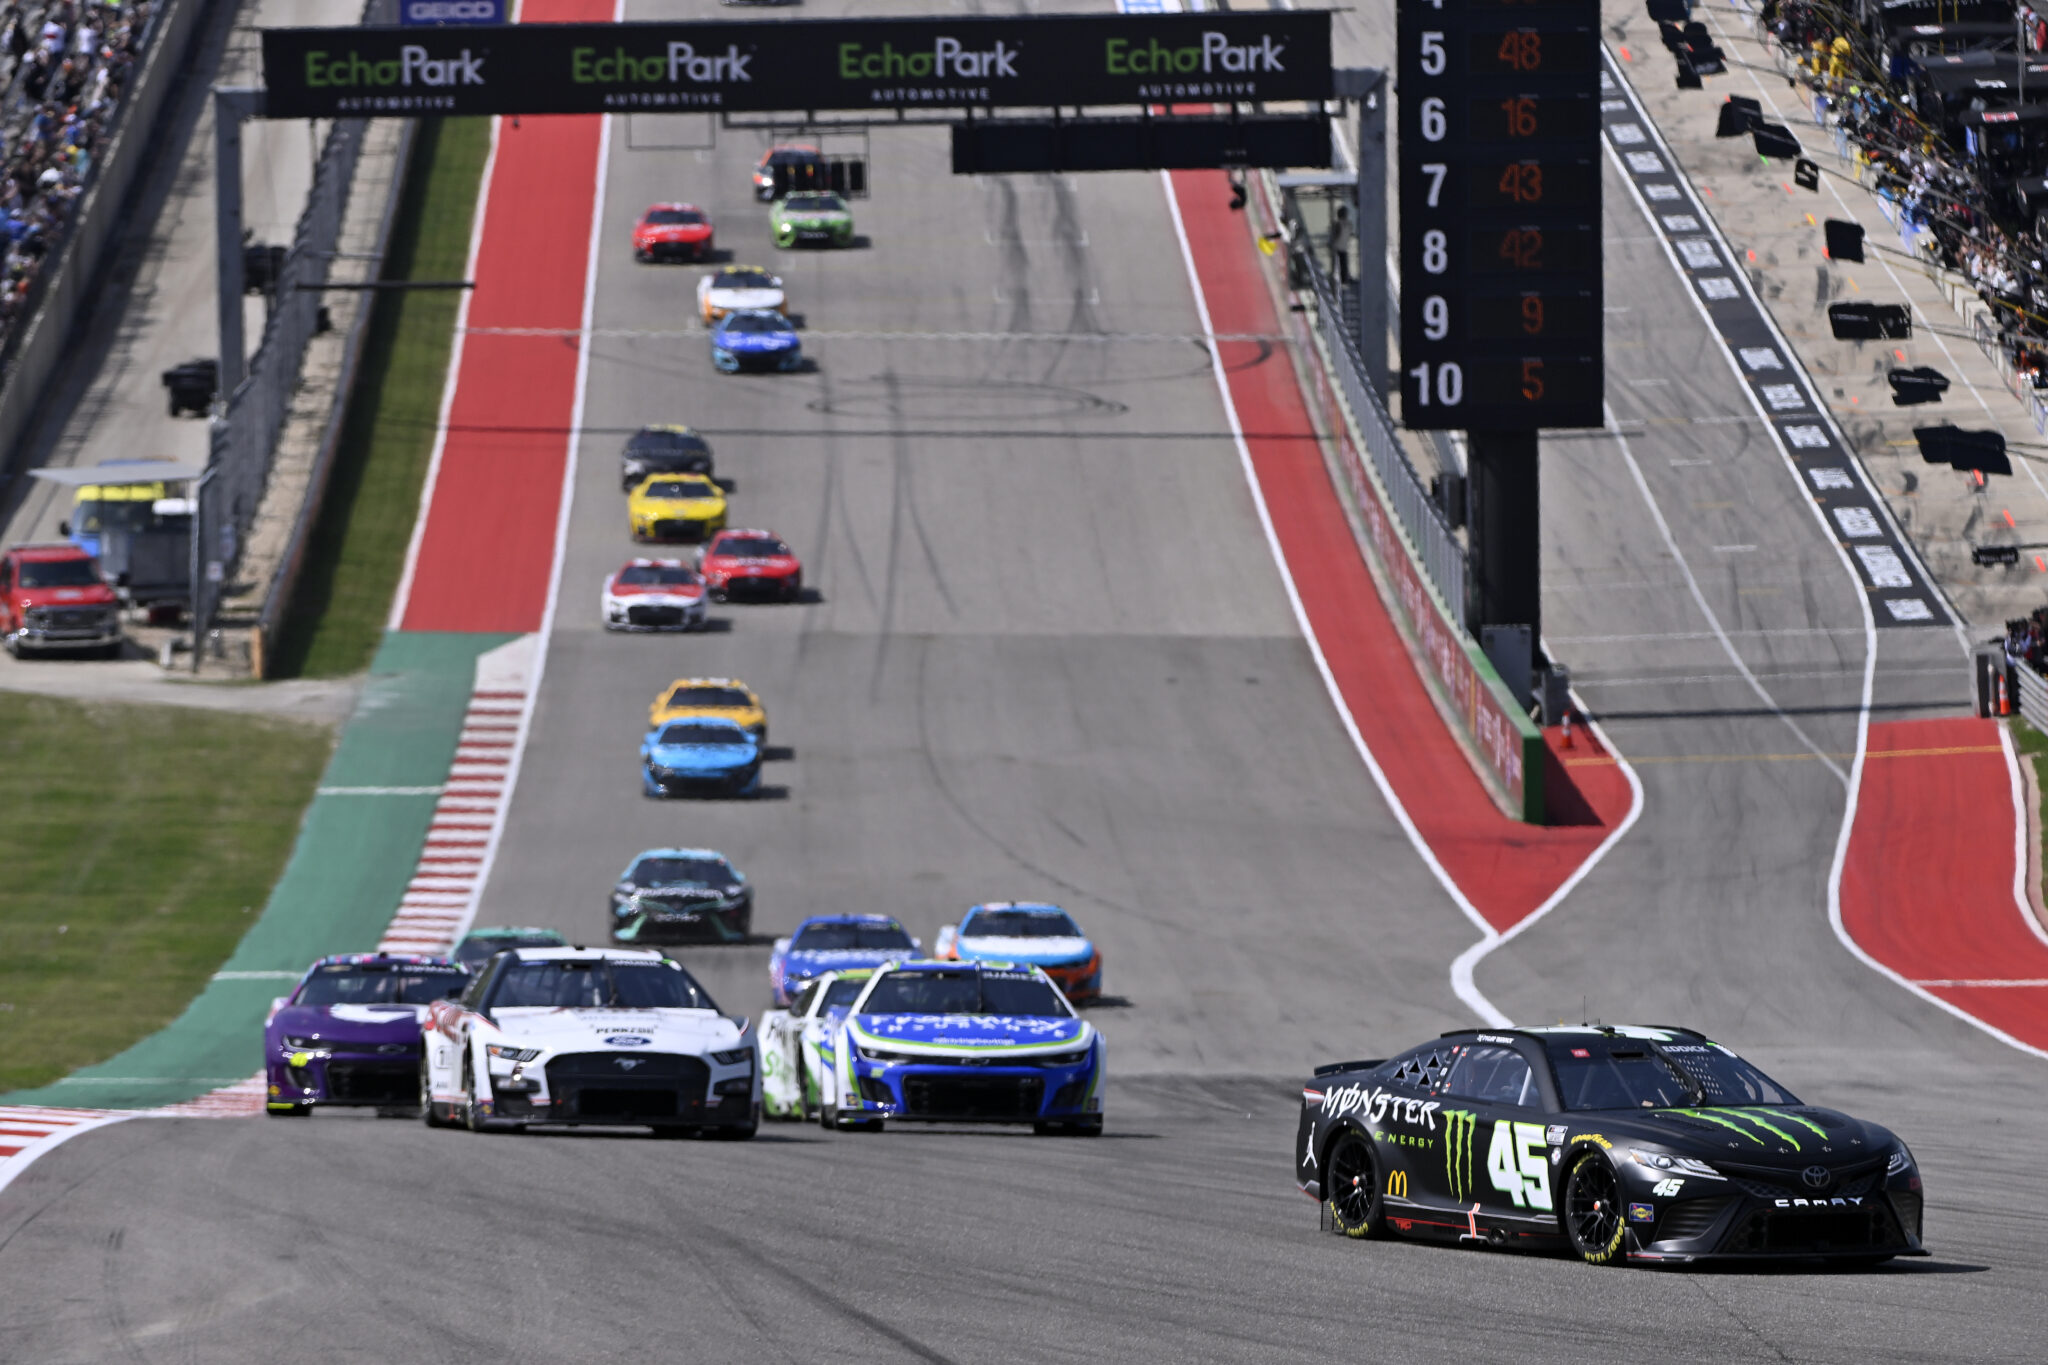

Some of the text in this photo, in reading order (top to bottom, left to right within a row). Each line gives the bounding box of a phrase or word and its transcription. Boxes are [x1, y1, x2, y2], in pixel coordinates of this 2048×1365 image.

[305, 45, 484, 88] EchoPark
[572, 41, 752, 84] EchoPark
[839, 37, 1017, 79] EchoPark
[1106, 31, 1286, 74] EchoPark
[1420, 31, 1541, 76] 5 48
[337, 96, 457, 111] AUTOMOTIVE
[604, 92, 723, 106] AUTOMOTIVE
[871, 87, 989, 101] AUTOMOTIVE
[1138, 82, 1257, 97] AUTOMOTIVE
[1420, 97, 1537, 142] 6 16
[1421, 163, 1543, 208] 7 43
[1422, 229, 1543, 274] 8 42
[1423, 295, 1544, 341] 9 9
[1410, 362, 1544, 407] 10 5
[1373, 1130, 1435, 1150] ENERGY
[1487, 1118, 1553, 1211] 45
[1652, 1178, 1686, 1198] 45
[1774, 1196, 1864, 1209] CAMRY
